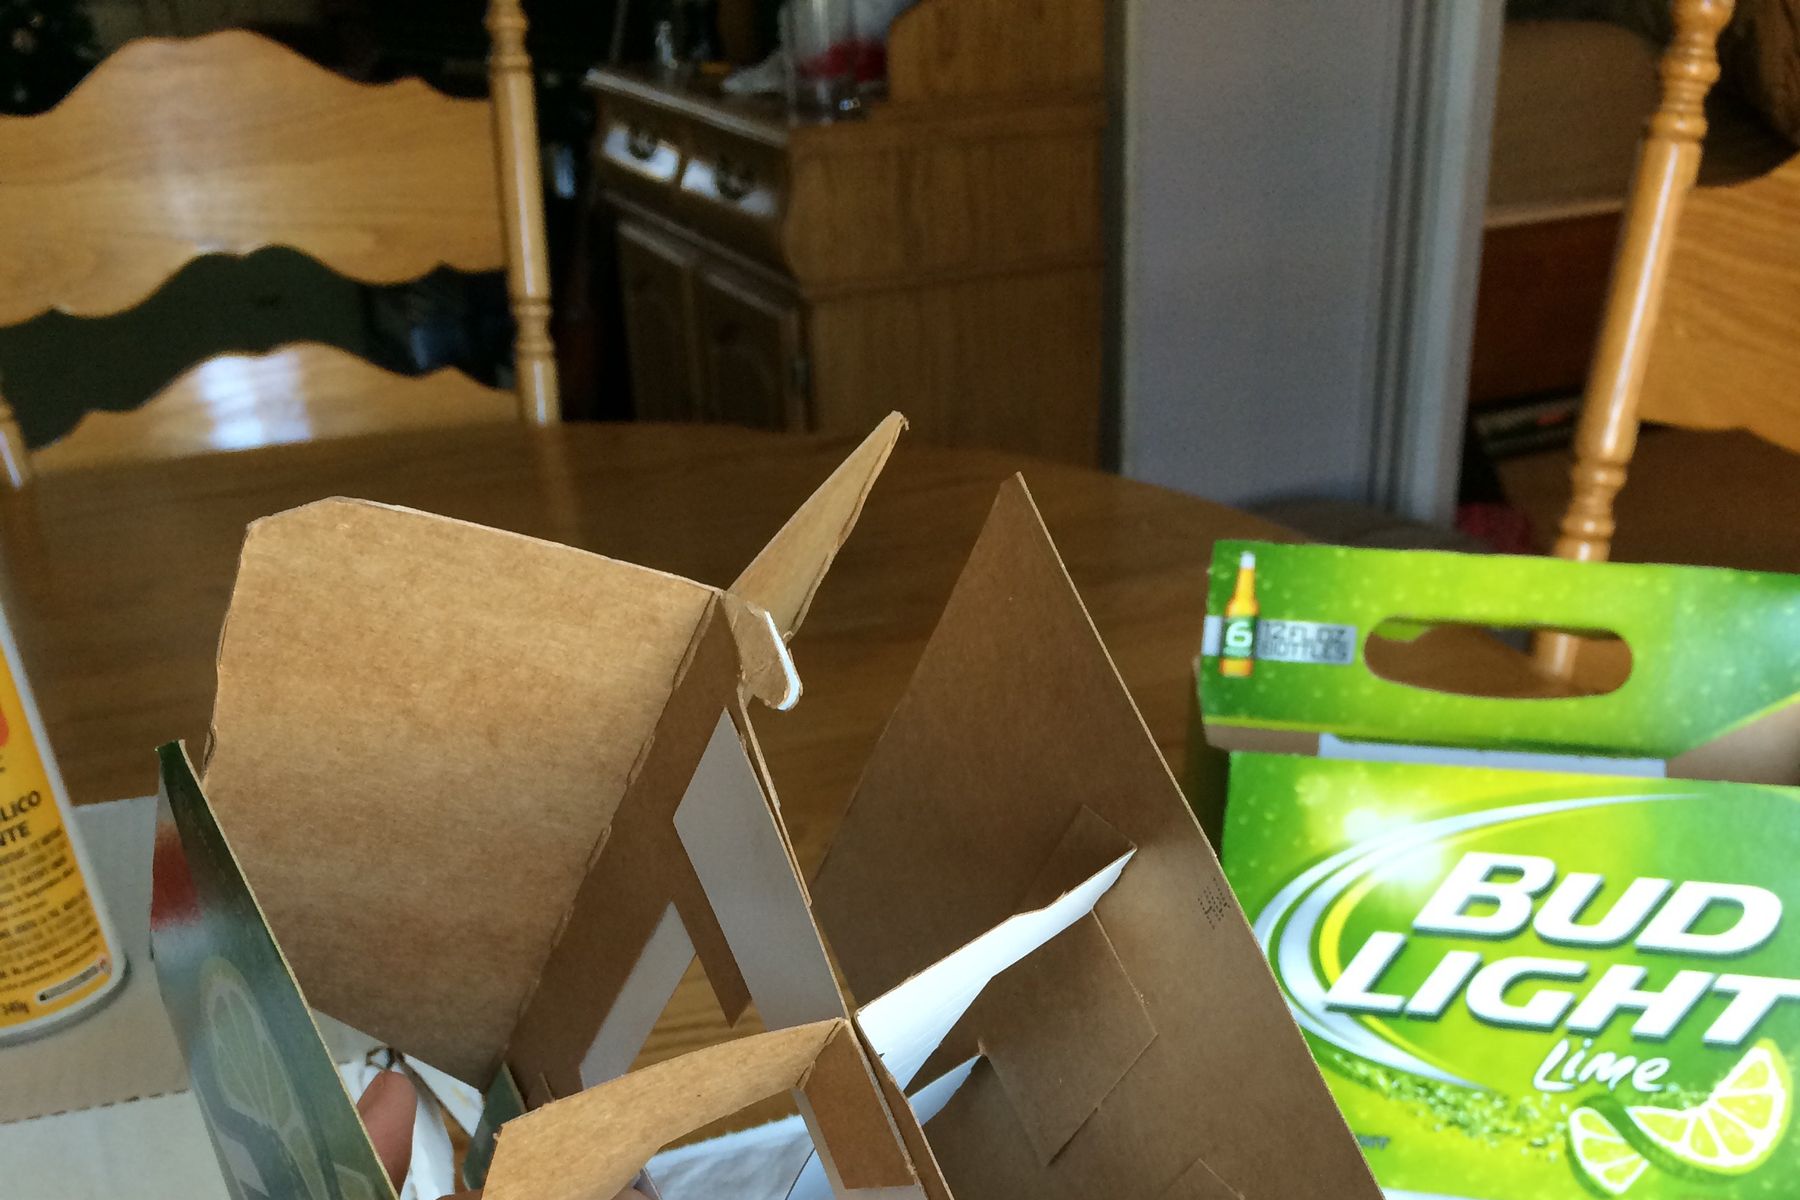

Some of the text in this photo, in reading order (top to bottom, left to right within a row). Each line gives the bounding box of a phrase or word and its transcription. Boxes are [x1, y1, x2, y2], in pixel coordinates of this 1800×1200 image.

[1225, 621, 1253, 648] 6
[1412, 851, 1783, 957] BUD
[1323, 931, 1800, 1046] LIGHT
[1534, 1038, 1671, 1093] Lime
